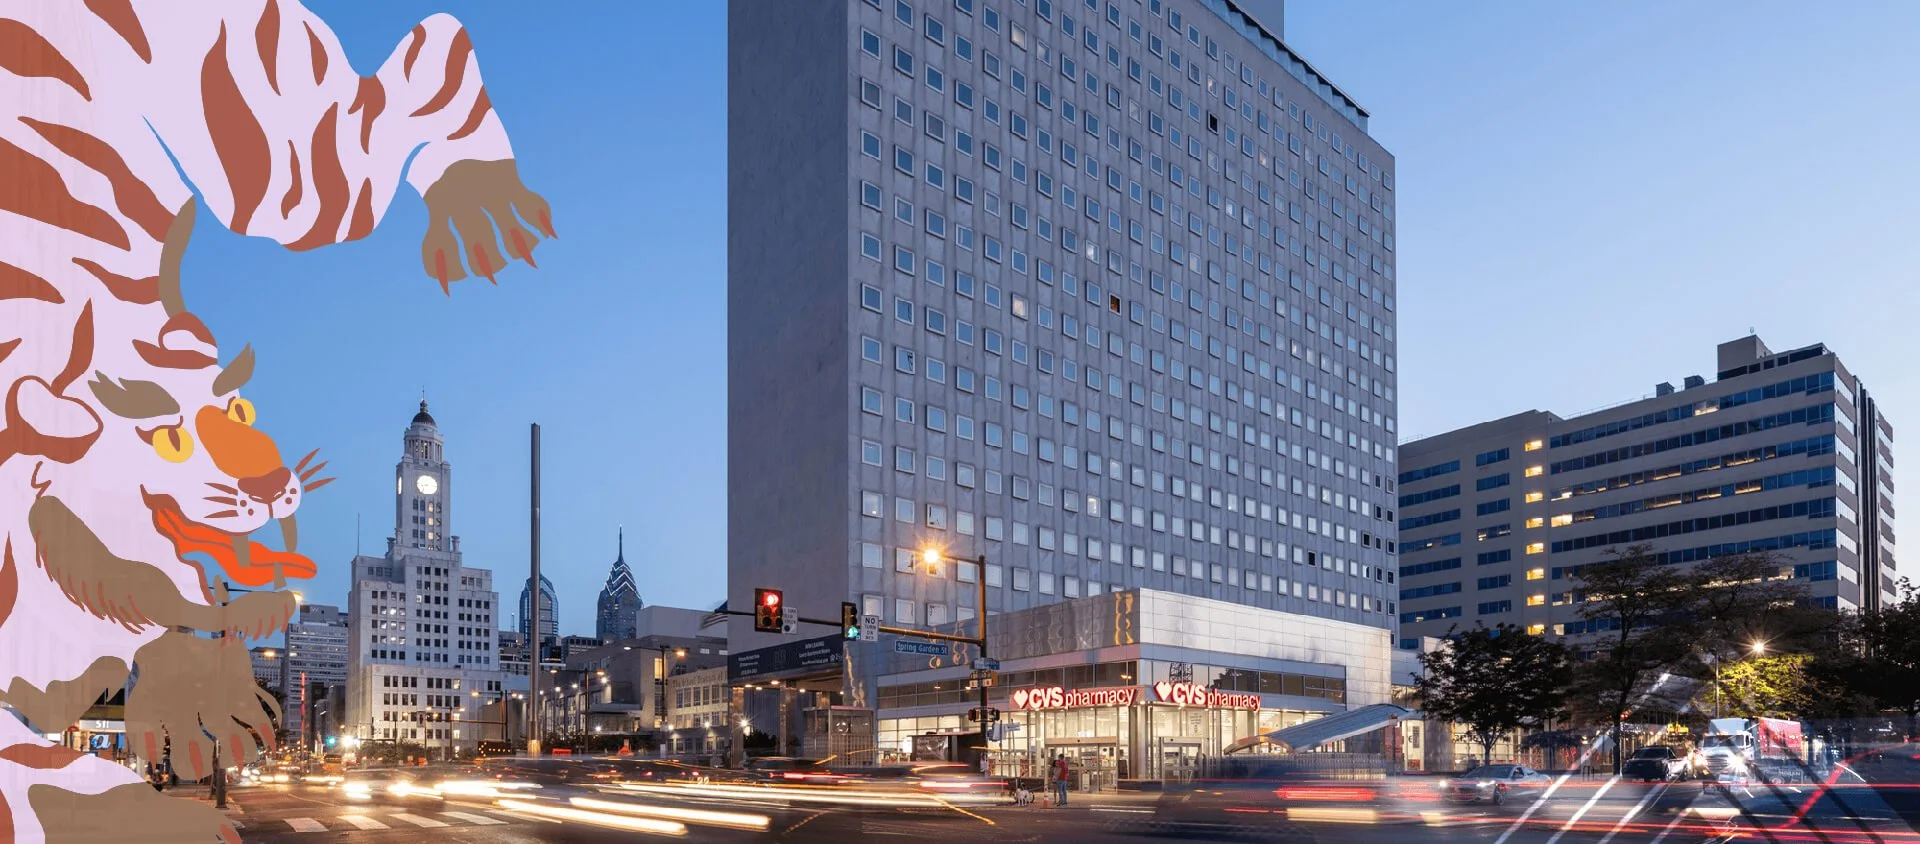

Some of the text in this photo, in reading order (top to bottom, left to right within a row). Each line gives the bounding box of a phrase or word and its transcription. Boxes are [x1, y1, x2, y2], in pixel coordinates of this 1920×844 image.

[865, 617, 876, 625] NO
[897, 642, 948, 654] Spring Garden St
[1029, 686, 1137, 709] CVS pharmacy
[1172, 682, 1261, 712] CVS pharmacy
